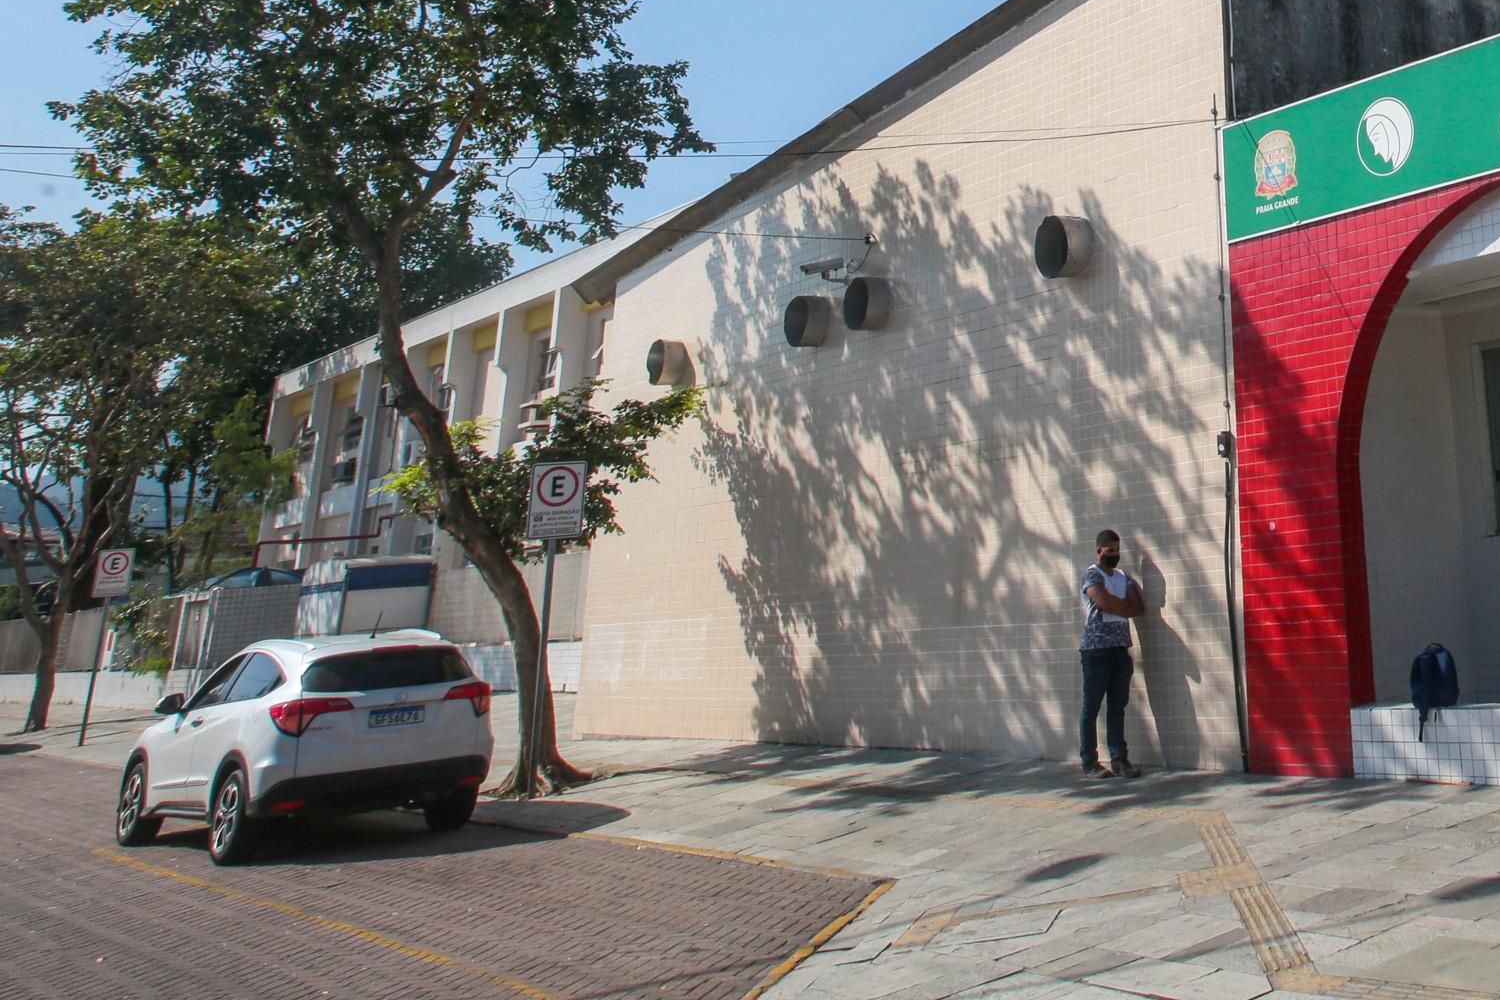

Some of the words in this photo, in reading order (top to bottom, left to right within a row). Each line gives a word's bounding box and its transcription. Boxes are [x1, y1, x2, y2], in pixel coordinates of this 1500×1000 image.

[1255, 202, 1274, 215] PRAIA
[1273, 196, 1299, 210] GRANDE
[551, 476, 566, 497] E
[110, 557, 121, 570] E
[375, 711, 420, 725] GFS6E76
